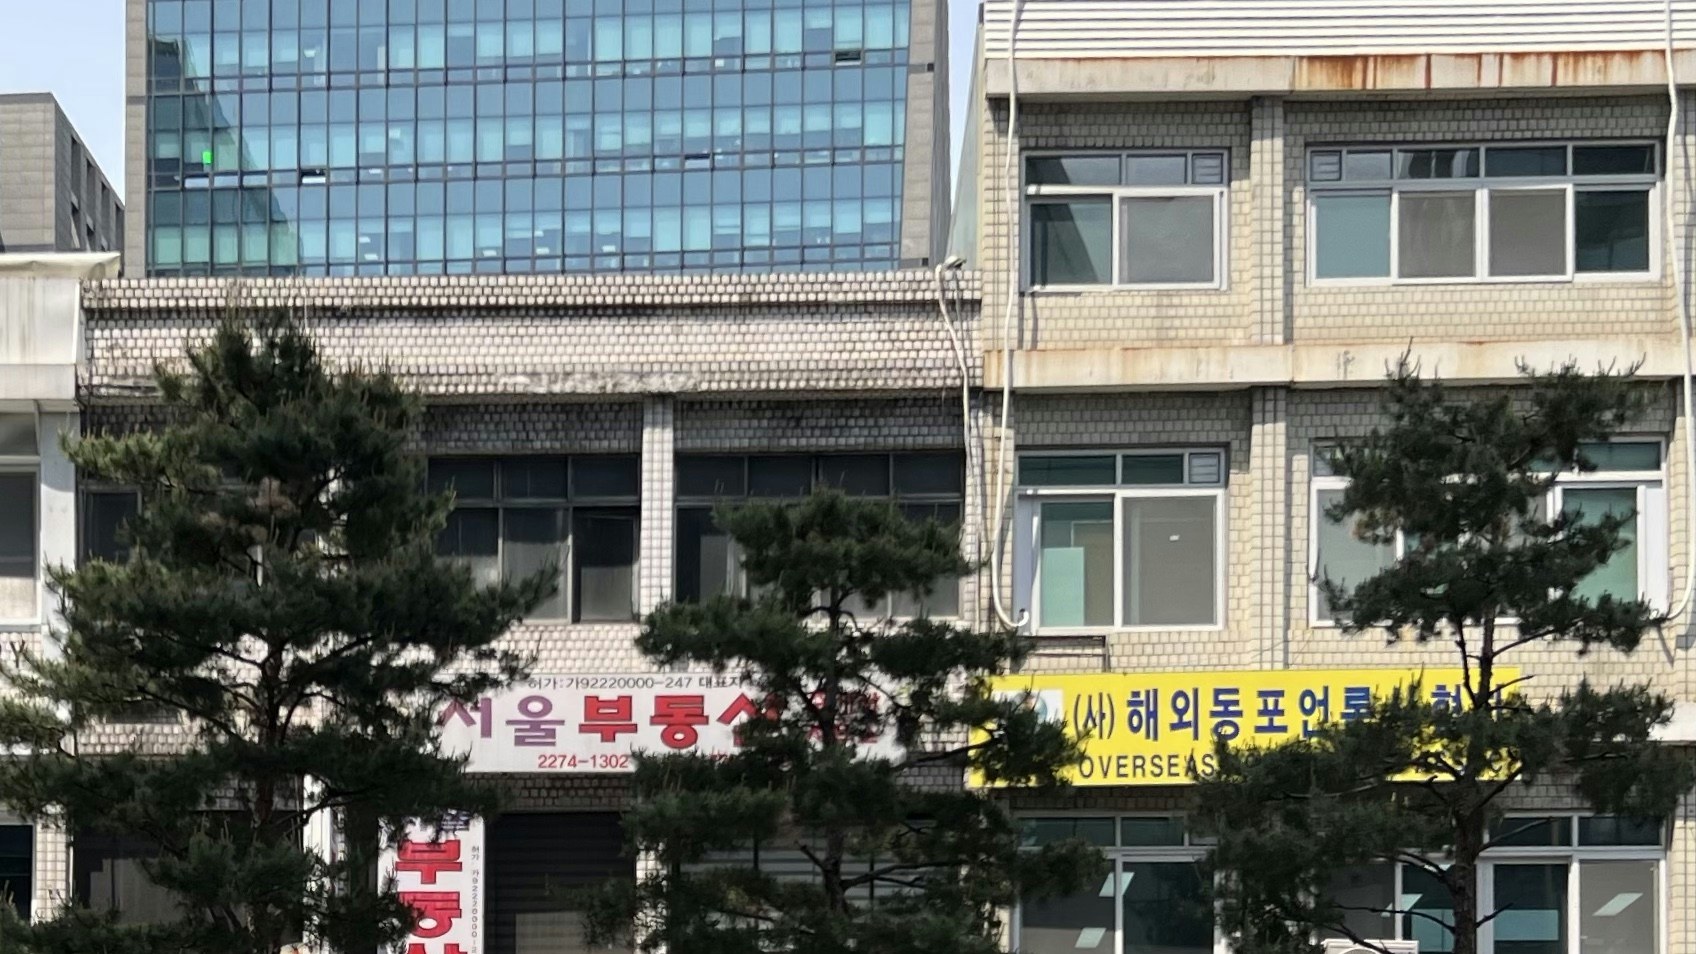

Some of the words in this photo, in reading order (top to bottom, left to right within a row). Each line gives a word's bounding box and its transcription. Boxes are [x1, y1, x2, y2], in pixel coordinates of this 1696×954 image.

[1074, 692, 1115, 740] (사)
[538, 754, 629, 769] 2274-1302
[1079, 752, 1215, 779] OVERSEAS
